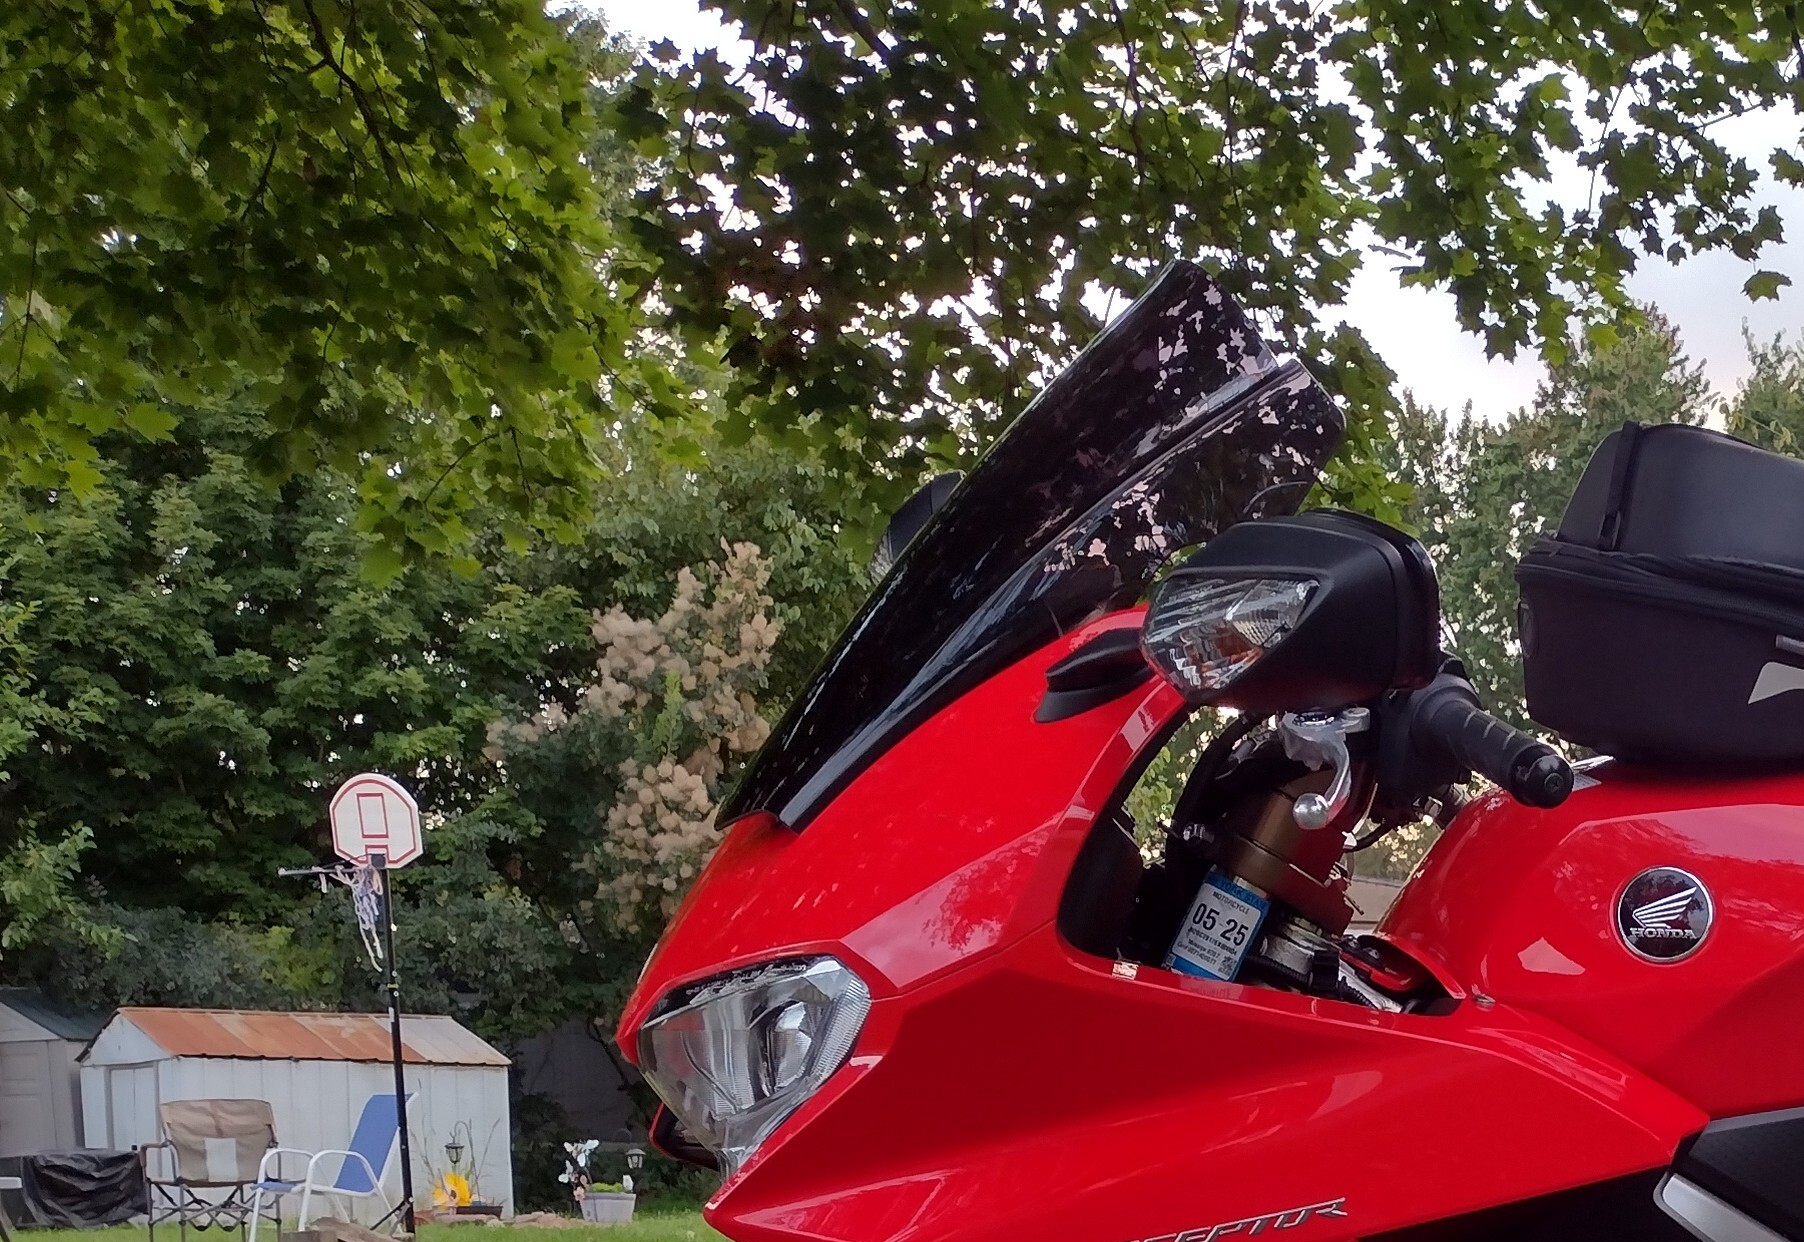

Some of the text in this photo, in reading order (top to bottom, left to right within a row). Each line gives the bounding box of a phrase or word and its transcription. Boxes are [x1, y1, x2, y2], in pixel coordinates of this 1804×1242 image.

[1193, 903, 1220, 930] 05
[1220, 919, 1249, 946] 25
[1630, 927, 1698, 940] HONDA
